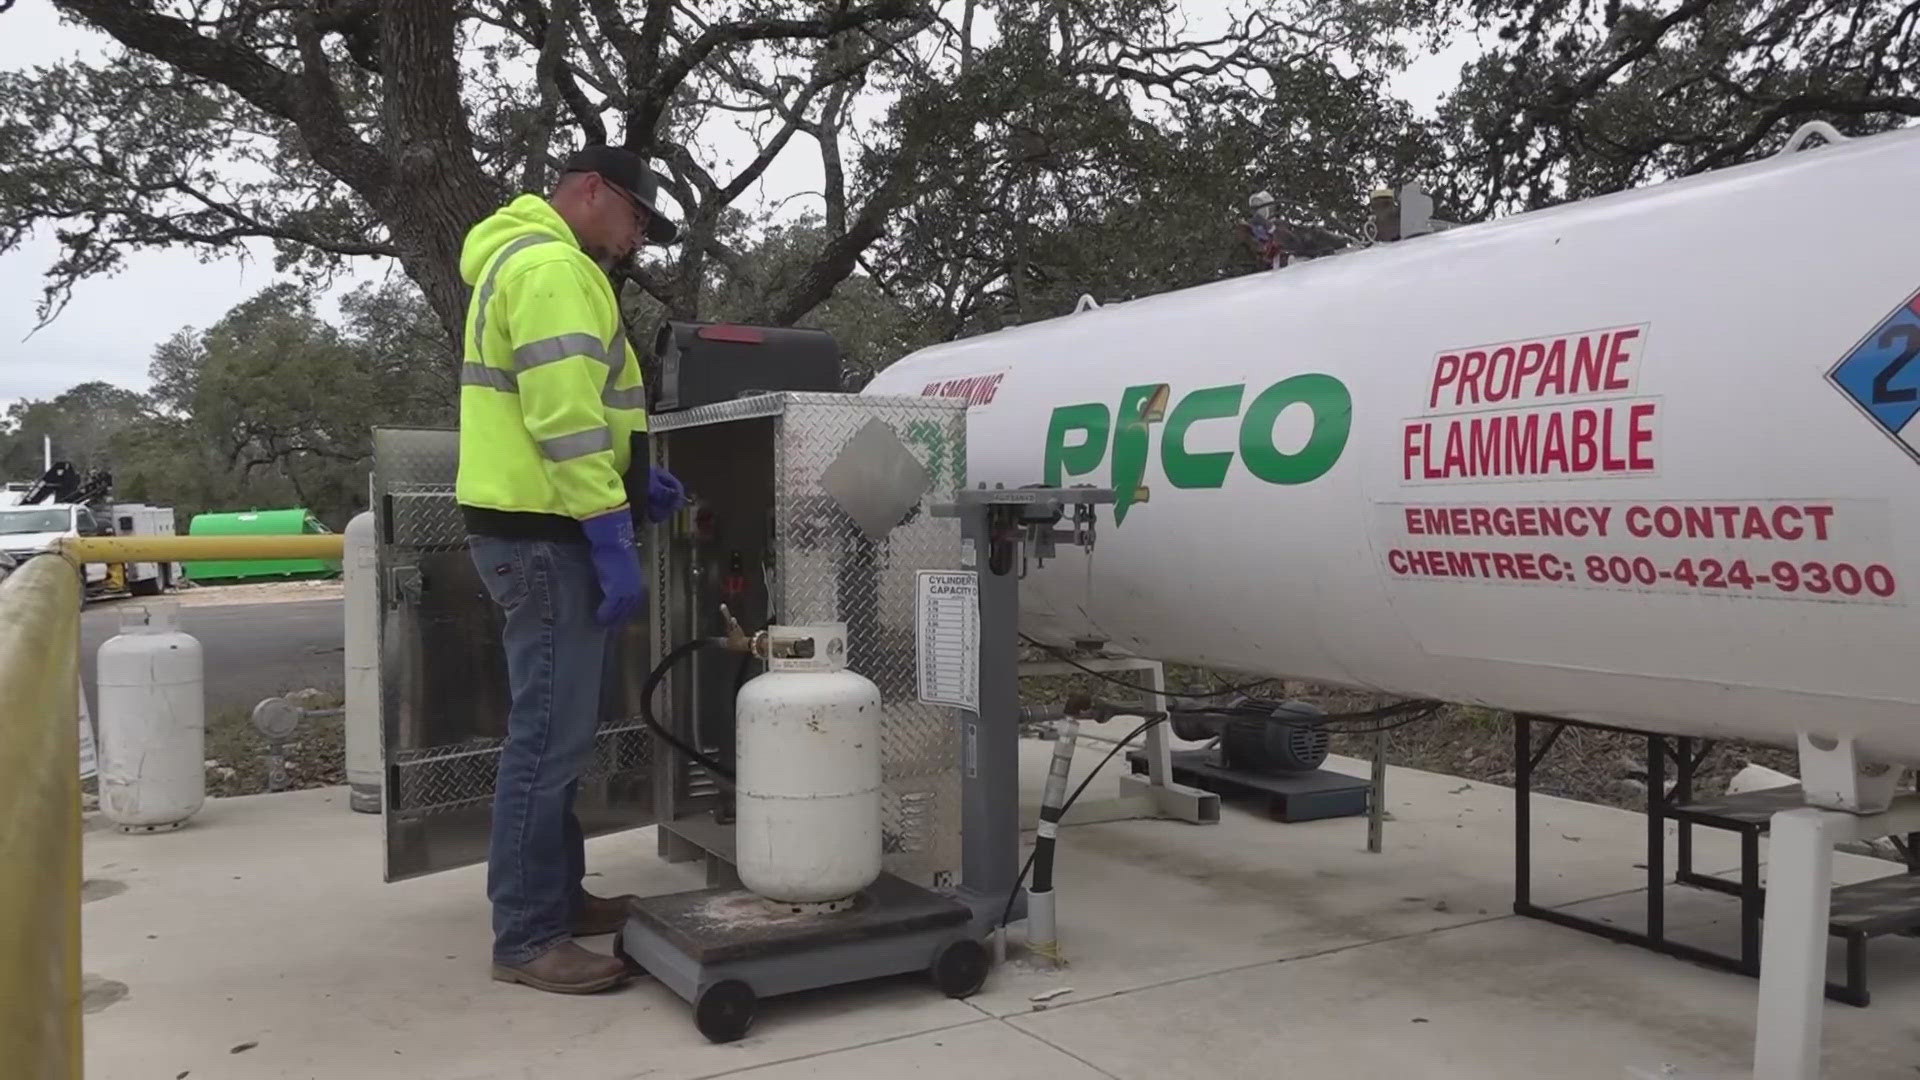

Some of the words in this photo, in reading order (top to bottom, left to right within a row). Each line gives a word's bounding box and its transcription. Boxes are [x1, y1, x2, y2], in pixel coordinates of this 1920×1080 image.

[940, 372, 1004, 406] SMOKING
[1429, 328, 1639, 409] PROPANE
[1872, 323, 1920, 404] 2
[1044, 372, 1353, 529] PICO
[1403, 403, 1656, 481] FLAMMABLE
[1404, 506, 1613, 537] EMERGENCY
[1625, 505, 1834, 541] CONTACT
[1387, 549, 1576, 583] CHEMTREC:
[1586, 556, 1896, 598] 800-424-9300
